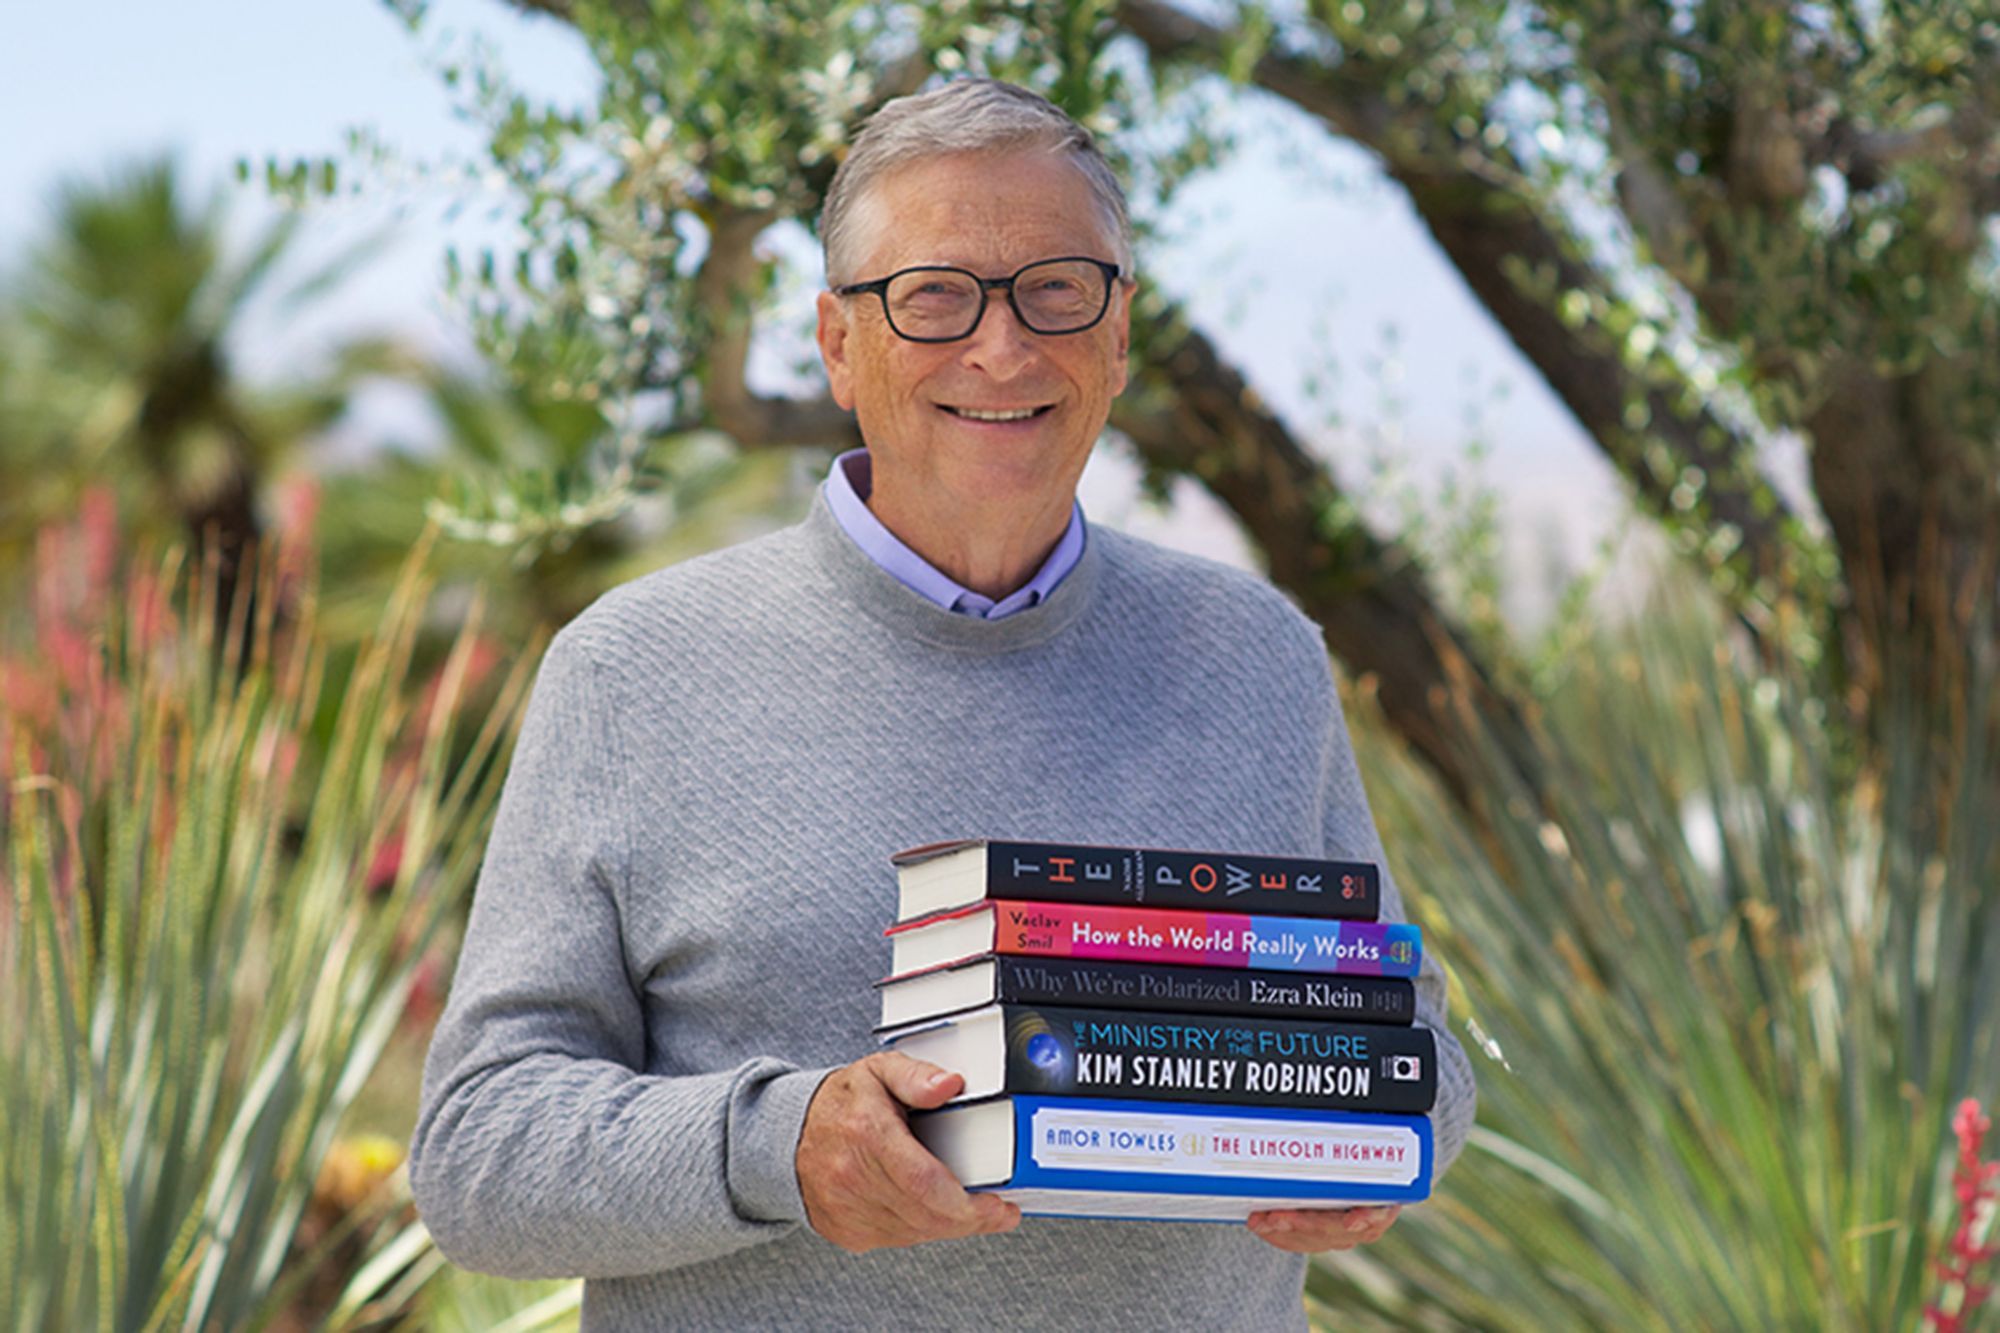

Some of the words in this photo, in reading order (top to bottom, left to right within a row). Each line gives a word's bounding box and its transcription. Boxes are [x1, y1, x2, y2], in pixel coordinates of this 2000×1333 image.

[1013, 857, 1112, 883] THE
[1156, 863, 1322, 897] POWER
[1009, 911, 1060, 929] Vaclav
[1017, 933, 1053, 949] Smil
[1072, 921, 1120, 945] How
[1127, 925, 1163, 948] the
[1170, 926, 1234, 951] World
[1242, 931, 1307, 964] Really
[1313, 935, 1380, 961] Works
[1014, 967, 1067, 997] Why
[1071, 970, 1134, 995] We're
[1139, 974, 1240, 1002] Polarized
[1250, 980, 1300, 1006] Ezra
[1305, 983, 1363, 1009] Klein
[1091, 1022, 1221, 1051] MINISTRY
[1224, 1028, 1254, 1042] FOR
[1228, 1042, 1254, 1057] THE
[1259, 1031, 1369, 1060] FUTURE
[1077, 1053, 1123, 1085] KIM
[1132, 1055, 1237, 1091] STANLEY
[1245, 1061, 1370, 1097] ROBINSON
[1046, 1128, 1101, 1148] AMOR
[1109, 1131, 1176, 1152] TOWLES
[1213, 1136, 1240, 1155] THE
[1250, 1140, 1324, 1159] LINCOLN
[1332, 1143, 1405, 1163] HIGHWAY
